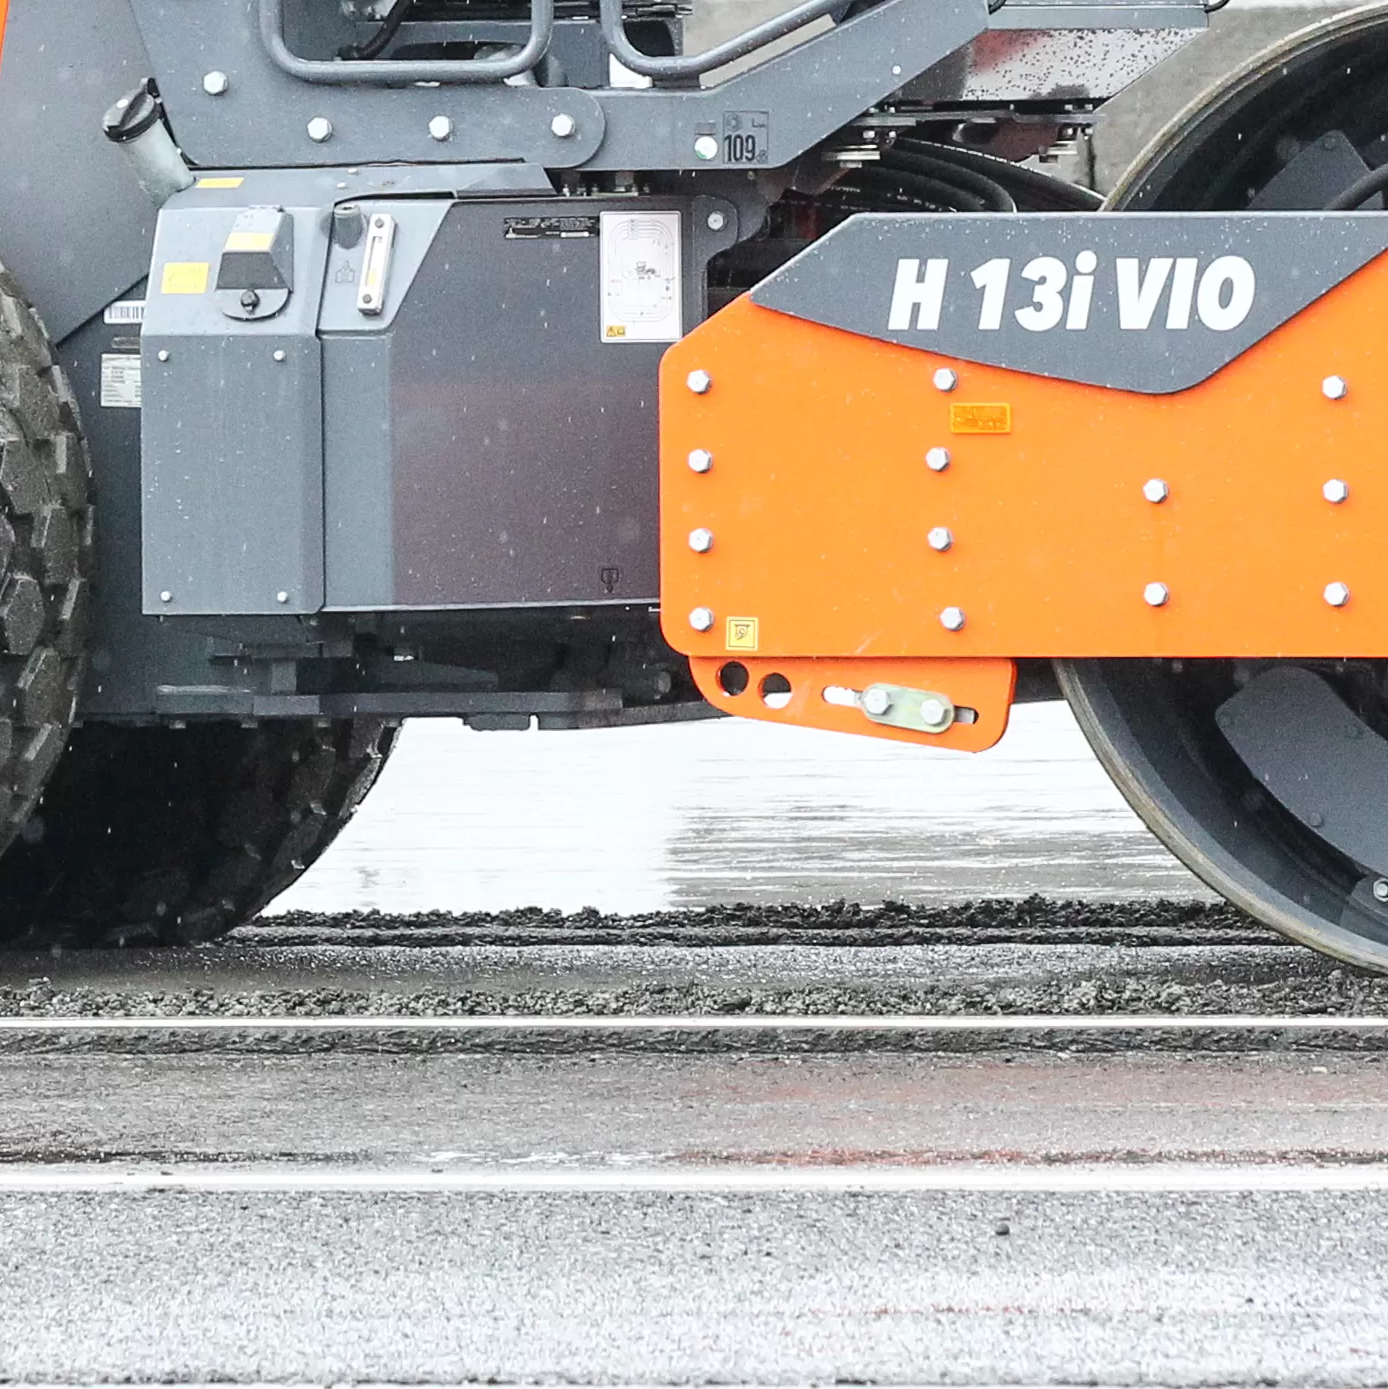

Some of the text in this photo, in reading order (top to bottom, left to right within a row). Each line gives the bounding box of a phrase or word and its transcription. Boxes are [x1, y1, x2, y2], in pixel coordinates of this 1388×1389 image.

[723, 134, 756, 162] 109
[887, 250, 1256, 332] H 13i VIO
